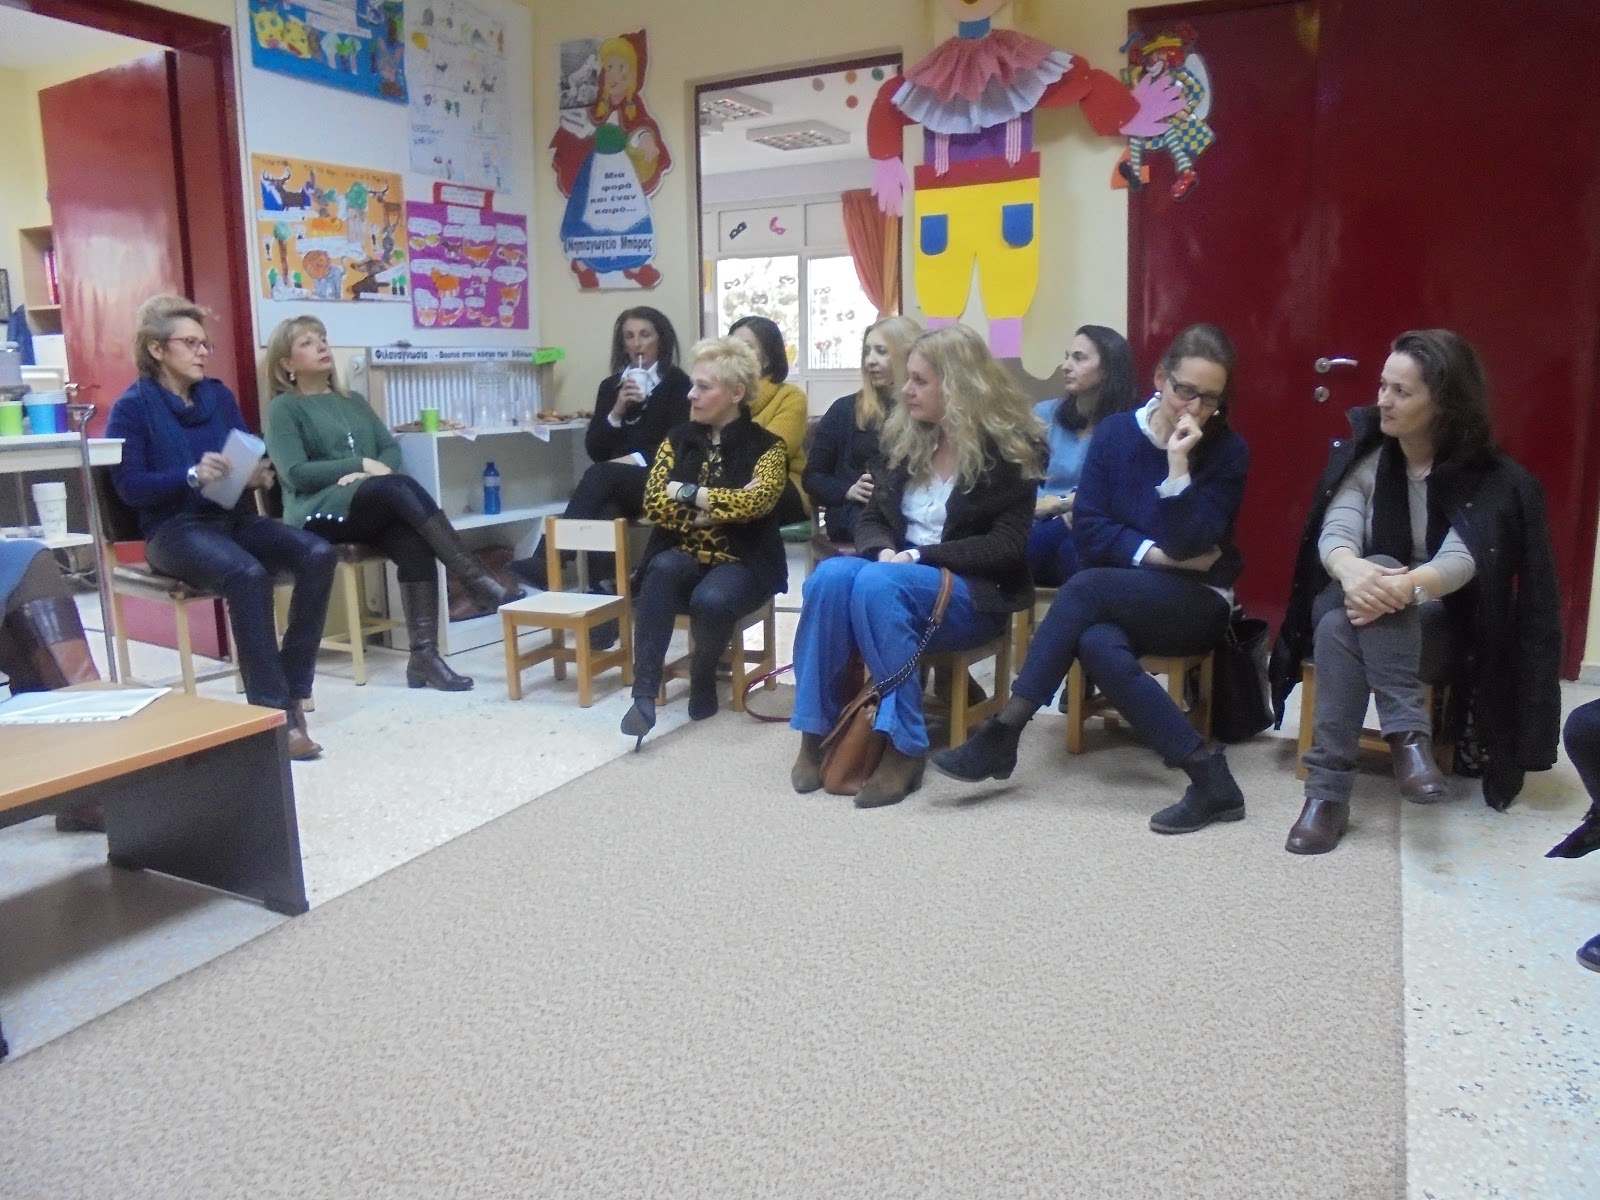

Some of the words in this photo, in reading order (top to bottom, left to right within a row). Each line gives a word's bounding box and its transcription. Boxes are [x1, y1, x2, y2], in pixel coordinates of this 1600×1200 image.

[604, 172, 625, 180] Μια
[601, 181, 632, 193] φορά
[610, 193, 637, 202] έναν
[567, 237, 617, 254] Νηπιαγωγείο
